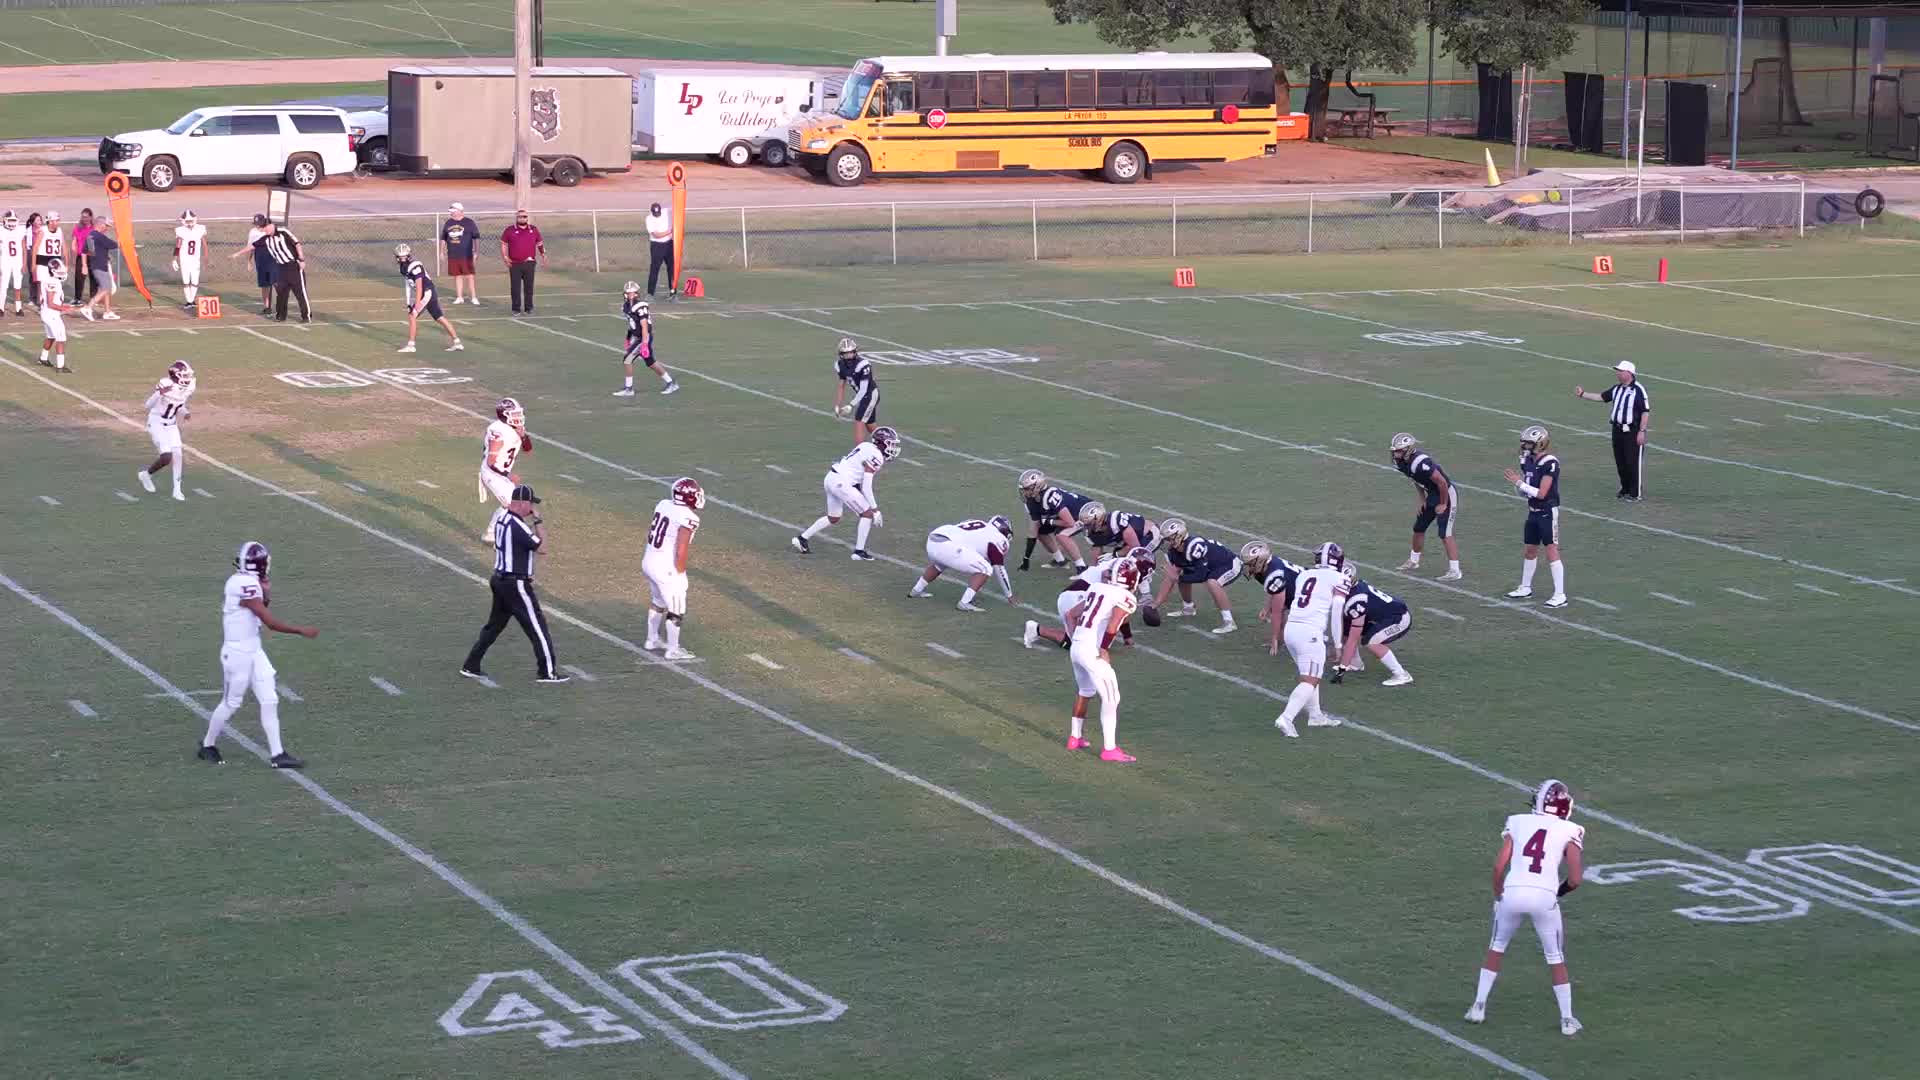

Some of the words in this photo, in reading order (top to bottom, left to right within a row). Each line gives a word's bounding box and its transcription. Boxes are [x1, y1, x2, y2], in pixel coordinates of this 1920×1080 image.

[678, 82, 703, 115] LP
[719, 111, 778, 131] Bulldogs
[1068, 137, 1090, 147] SCHOOL
[1091, 137, 1102, 147] BUS
[9, 240, 17, 257] 6
[188, 240, 196, 256] 8
[1600, 258, 1610, 272] G
[685, 279, 698, 295] 20
[1179, 270, 1193, 285] 10
[200, 299, 218, 316] 30
[503, 447, 517, 469] 3
[1297, 577, 1317, 608] 9
[1078, 592, 1104, 628] 21
[1522, 828, 1547, 873] 4
[1582, 843, 1920, 922] 30
[437, 951, 849, 1048] 40
